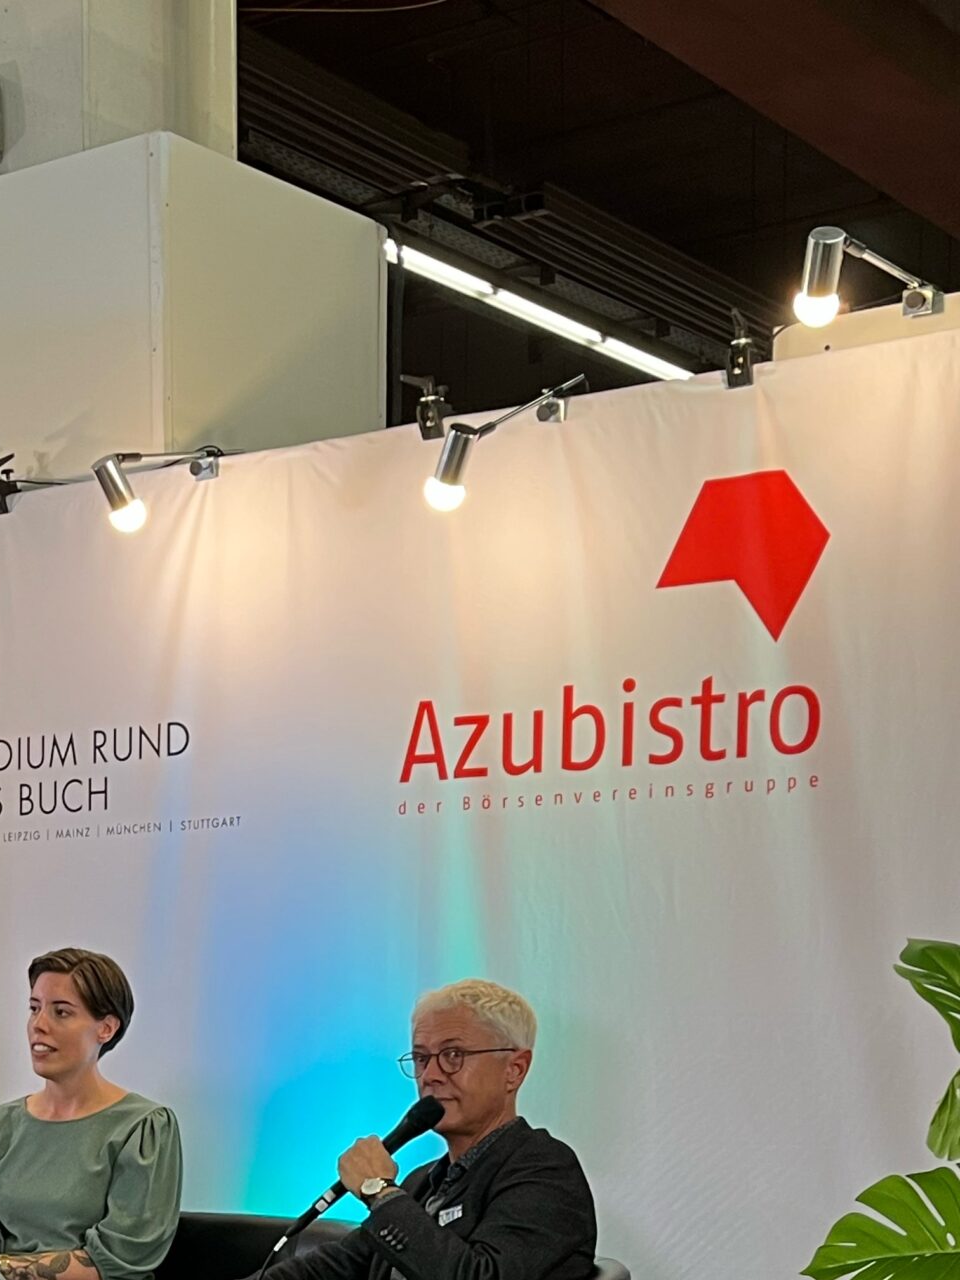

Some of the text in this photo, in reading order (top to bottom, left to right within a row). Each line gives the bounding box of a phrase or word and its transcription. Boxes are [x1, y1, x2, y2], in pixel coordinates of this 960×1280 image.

[92, 722, 190, 764] RUND
[399, 676, 821, 783] Azubistro
[19, 777, 108, 816] BUCH
[398, 774, 820, 816] der Börsenvereinsgruppe
[3, 830, 41, 843] LEIPZIG
[55, 827, 90, 840] MAINZ
[106, 822, 162, 836] MÜNCHEN
[180, 816, 242, 831] STUTTGART
